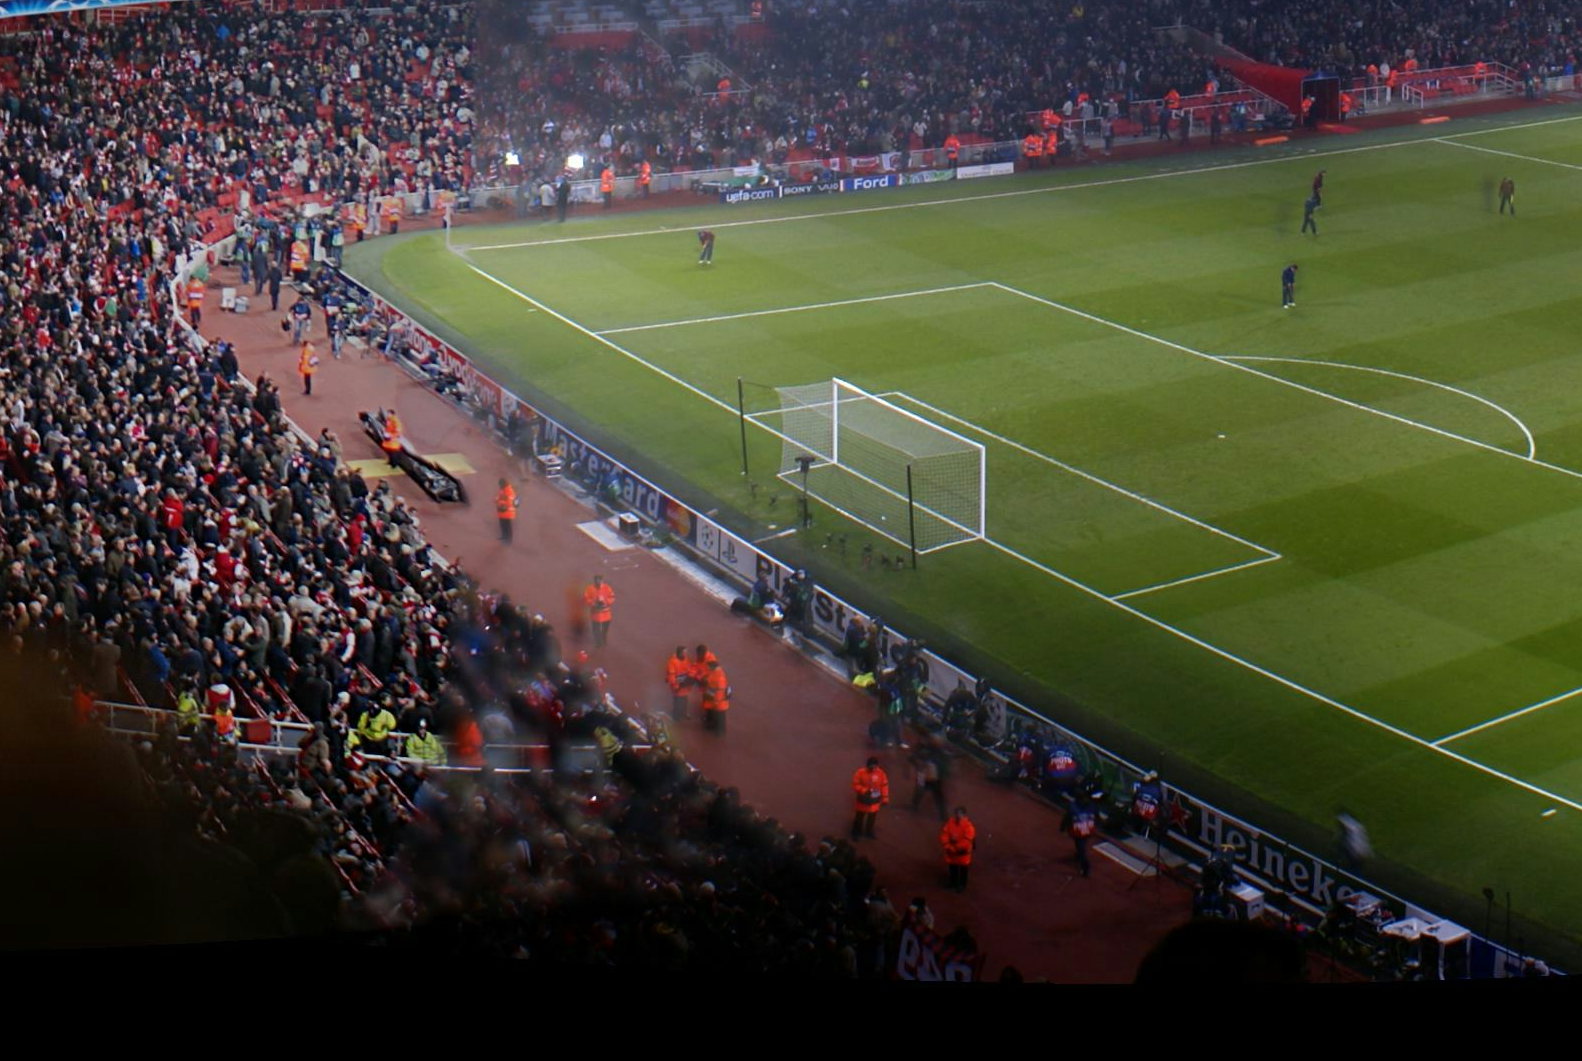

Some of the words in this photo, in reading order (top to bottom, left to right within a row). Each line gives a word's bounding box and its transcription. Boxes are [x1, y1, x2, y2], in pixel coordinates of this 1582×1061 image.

[784, 184, 813, 195] SONY
[854, 175, 889, 190] Ford
[1199, 803, 1362, 906] Heineke
